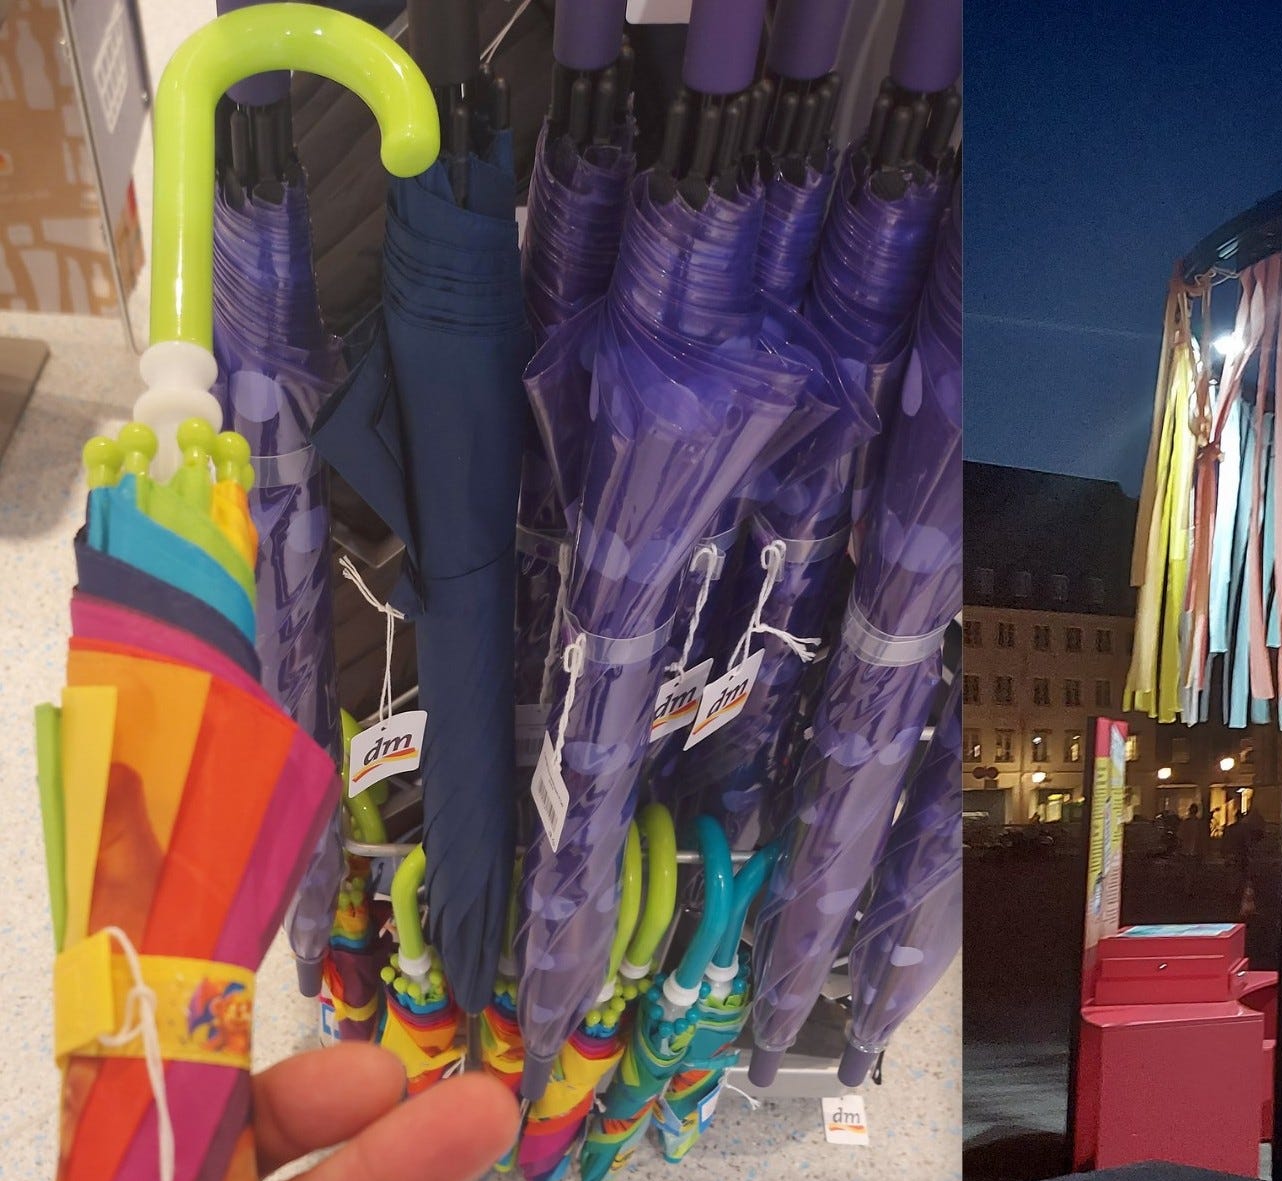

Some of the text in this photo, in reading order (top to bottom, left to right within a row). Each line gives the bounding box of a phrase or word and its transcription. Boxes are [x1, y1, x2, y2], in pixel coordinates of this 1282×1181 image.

[654, 684, 697, 720] dm
[708, 678, 750, 717] dm
[363, 732, 413, 767] dm
[831, 1106, 861, 1124] dm
